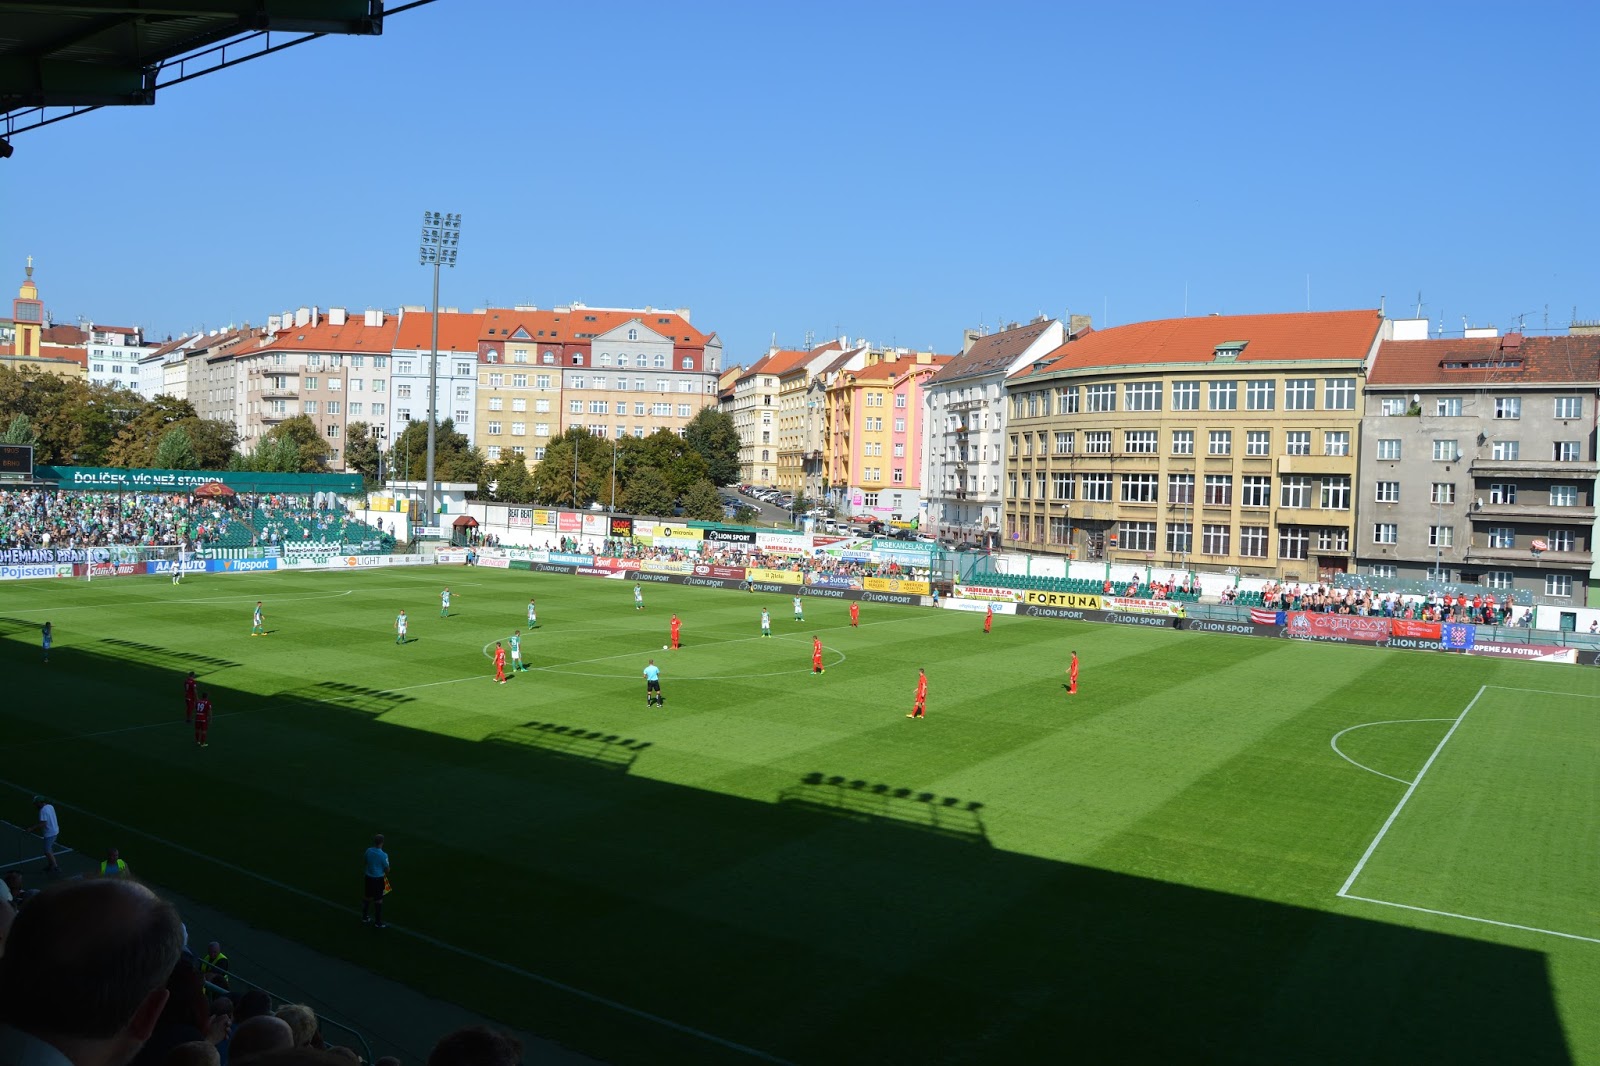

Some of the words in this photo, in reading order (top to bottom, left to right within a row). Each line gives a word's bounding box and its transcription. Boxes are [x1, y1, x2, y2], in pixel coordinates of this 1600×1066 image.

[132, 472, 151, 484] VÍC
[153, 474, 175, 486] NEŽ
[520, 509, 532, 519] BEAT
[718, 533, 732, 541] LION
[733, 534, 751, 542] SPORT
[233, 560, 269, 571] Tipsport
[0, 565, 72, 579] Pojisteni.cz
[692, 578, 705, 586] LION
[829, 576, 848, 584] Šutka
[824, 590, 844, 598] SPORT
[872, 595, 889, 603] LION
[889, 596, 911, 604] SPORT
[1028, 593, 1097, 607] FORTUNA
[1038, 608, 1057, 616] LION
[1058, 611, 1083, 619] SPORT
[1118, 615, 1138, 623] LION
[1140, 618, 1166, 626] SPORT
[1203, 623, 1225, 631] LION
[1226, 625, 1254, 634] SPORT
[1392, 638, 1417, 648] LION
[1418, 640, 1448, 650] SPOR
[1472, 644, 1500, 653] OPEME
[1502, 646, 1511, 654] ZA
[1513, 647, 1543, 656] FOTBAL
